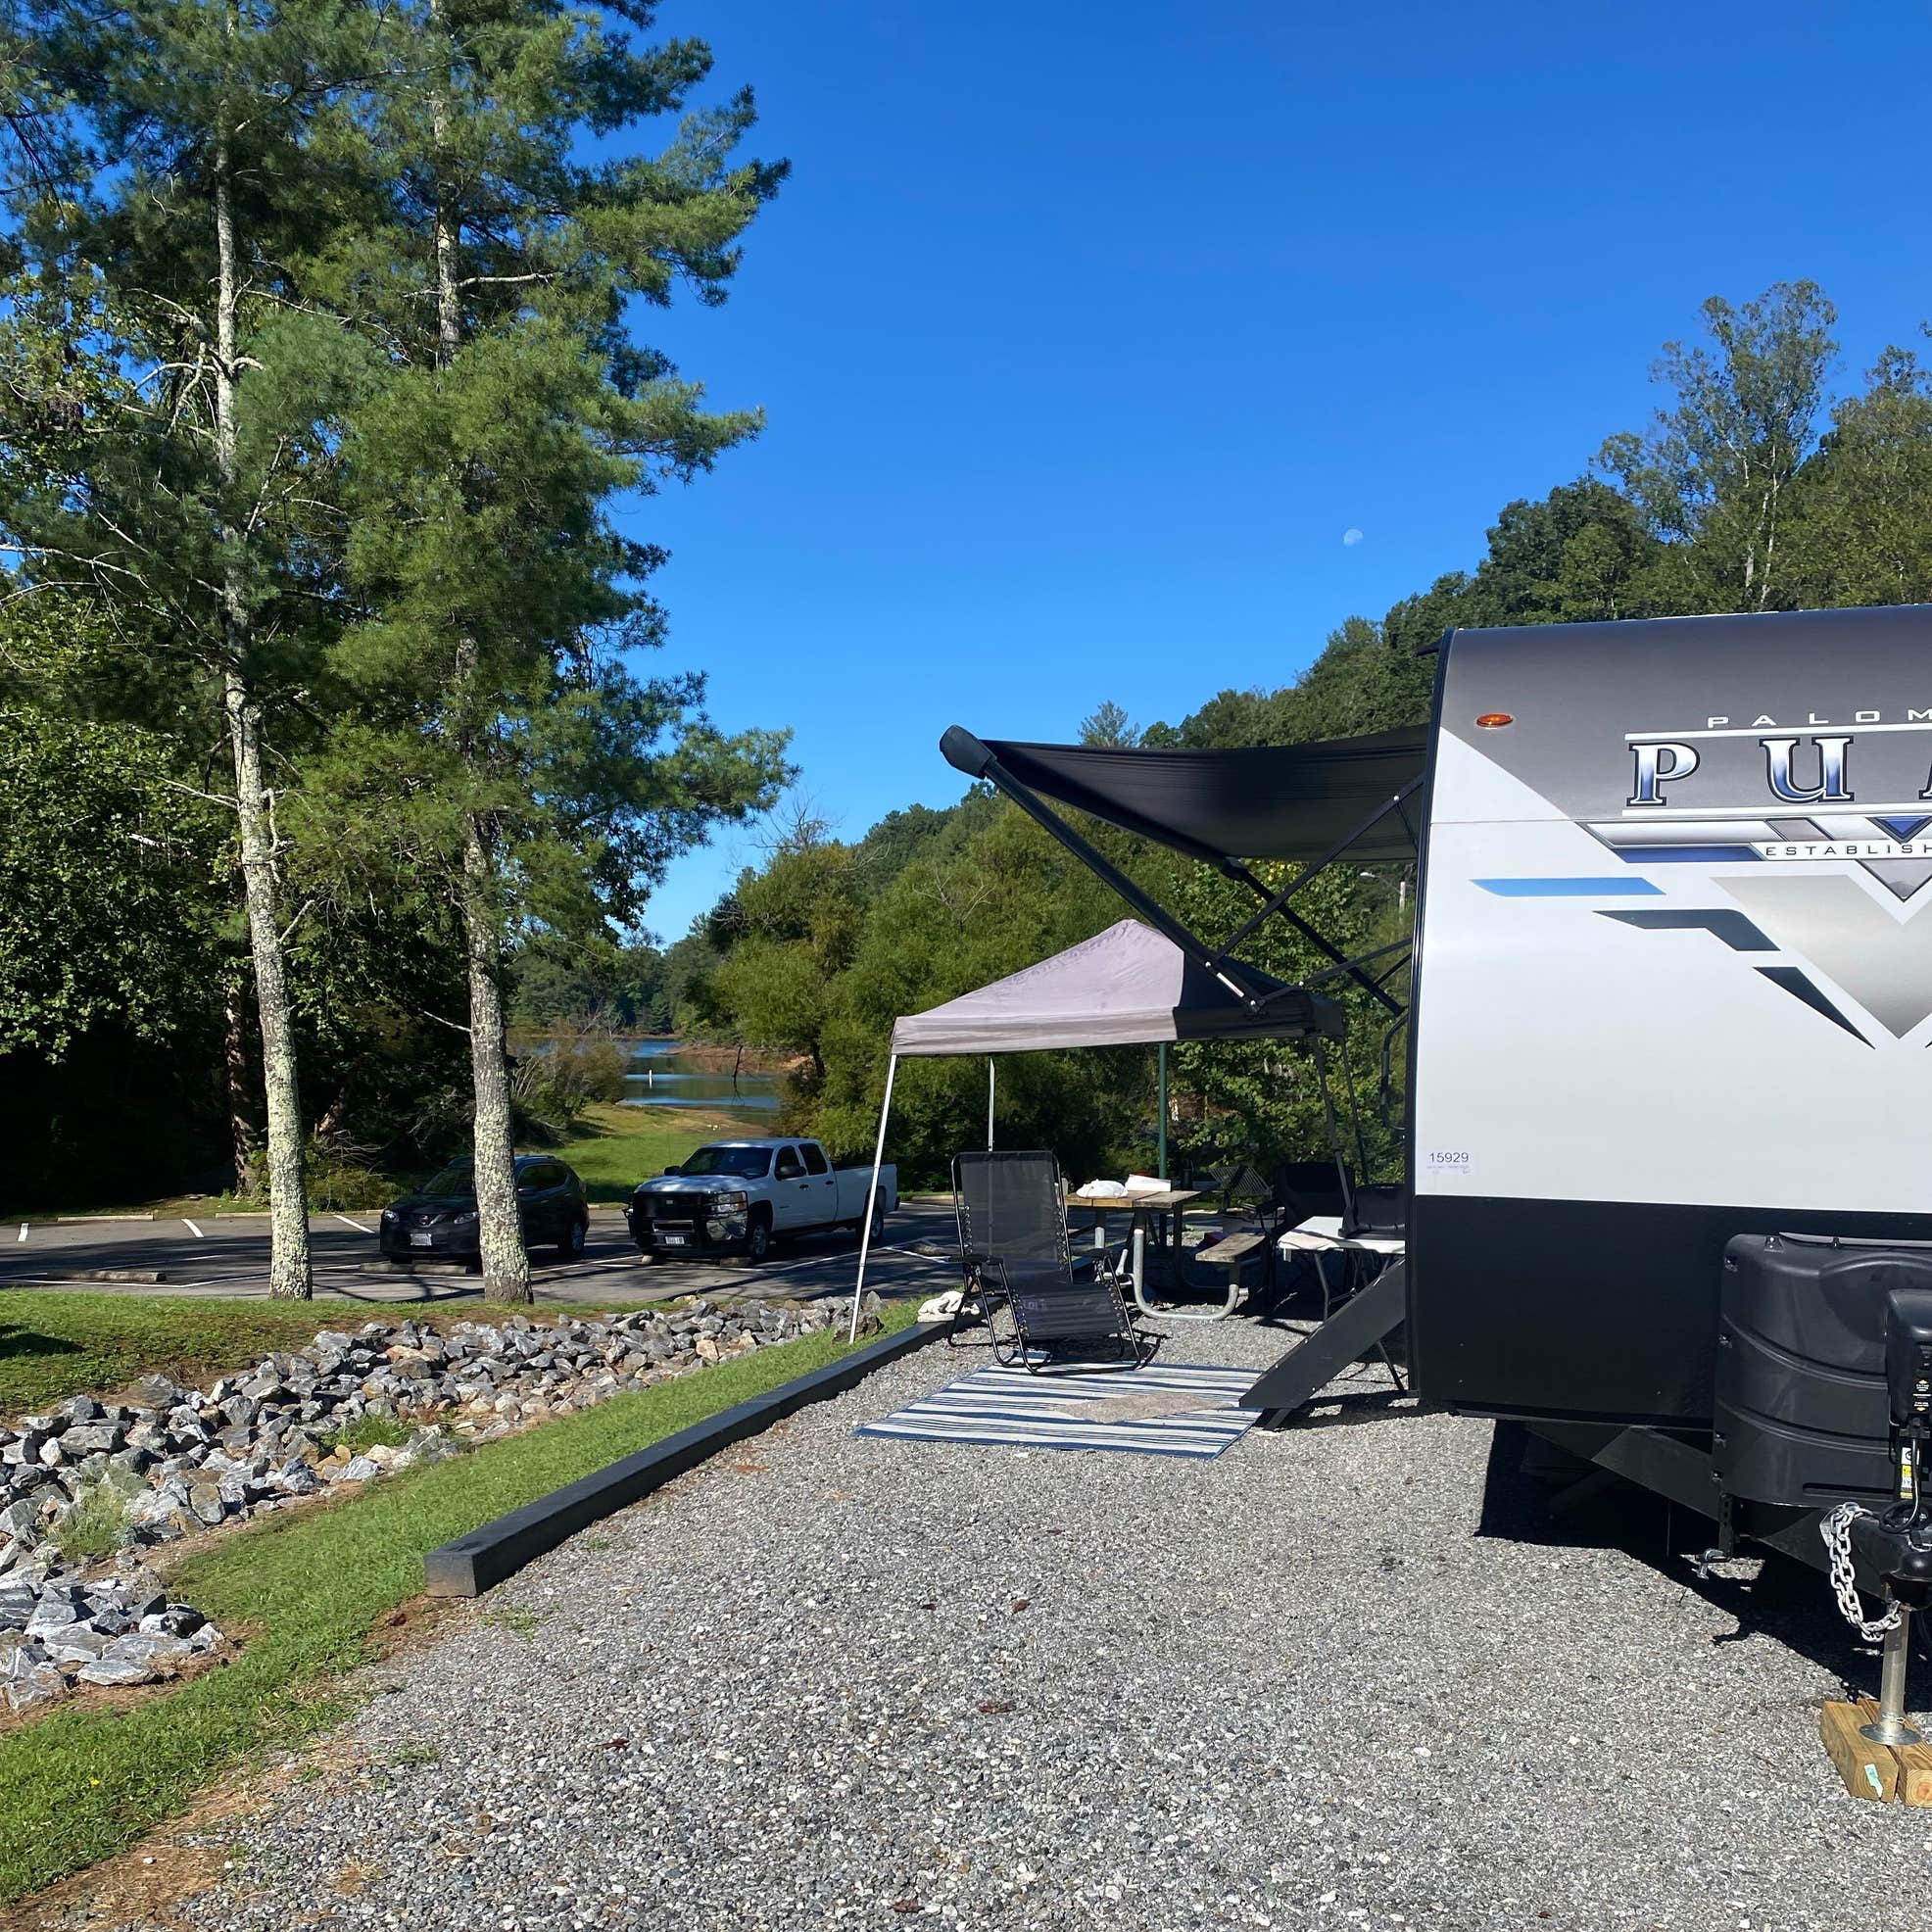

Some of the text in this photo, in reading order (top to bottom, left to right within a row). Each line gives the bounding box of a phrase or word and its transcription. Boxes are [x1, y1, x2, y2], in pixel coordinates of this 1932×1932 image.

[1708, 709, 1932, 728] PALOM
[1626, 736, 1932, 806] PU
[1765, 844, 1932, 856] ESTABLISH
[1428, 1151, 1470, 1163] 15929
